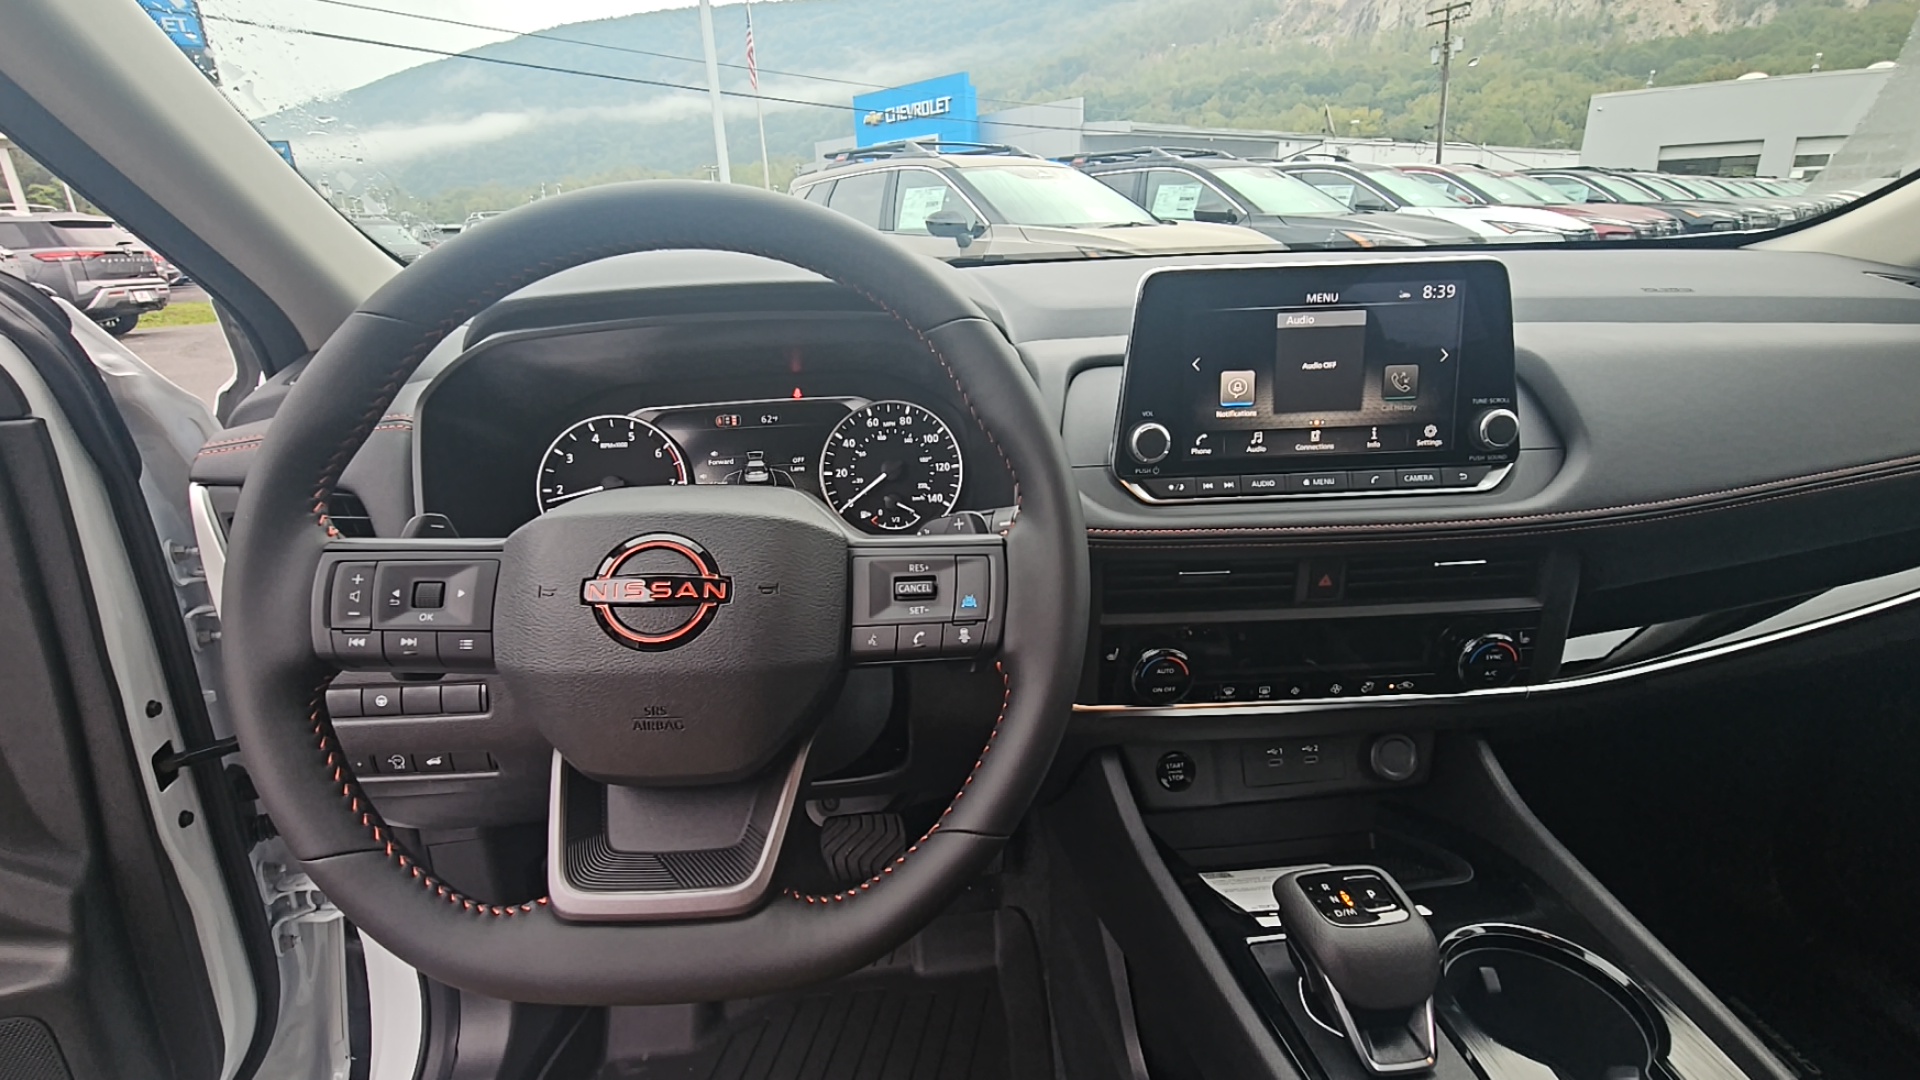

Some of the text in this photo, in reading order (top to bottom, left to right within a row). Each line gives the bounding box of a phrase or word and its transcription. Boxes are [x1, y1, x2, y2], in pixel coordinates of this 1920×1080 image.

[885, 96, 952, 123] CHEVROLET
[1422, 284, 1456, 299] 8:39
[1306, 293, 1339, 303] MENU
[1286, 315, 1315, 325] Audio
[1302, 361, 1337, 370] Audio OFF
[1381, 404, 1417, 412] Call History
[1216, 410, 1257, 418] Notifications
[866, 417, 879, 428] 60
[899, 416, 912, 425] 80
[591, 433, 600, 443] 4
[628, 431, 635, 441] 5
[923, 434, 939, 443] 100
[842, 439, 856, 448] 40
[1295, 442, 1335, 451] Connections
[1366, 440, 1381, 448] Info
[1416, 439, 1443, 448] Settings
[655, 449, 662, 458] 6
[1190, 447, 1212, 455] Phone
[1246, 445, 1267, 453] Audio
[566, 453, 574, 464] 3
[707, 458, 734, 466] Forward
[792, 456, 805, 464] OFF
[935, 462, 950, 471] 120
[835, 468, 848, 478] 20
[1312, 477, 1335, 486] MENU
[1404, 474, 1434, 483] CAMERA
[1251, 480, 1276, 488] AUDIO
[555, 484, 564, 495] 2
[927, 493, 943, 503] 140
[908, 563, 930, 572] RES+
[586, 580, 727, 599] NISSAN
[898, 584, 932, 593] CANCEL
[418, 613, 434, 622] OK
[643, 705, 668, 716] SRS
[632, 720, 685, 731] AIRBAG
[1166, 762, 1184, 770] START
[1168, 774, 1185, 782] STOP
[1321, 883, 1331, 891] R
[1366, 889, 1376, 899] P
[1328, 895, 1340, 904] N
[1334, 907, 1358, 918] D/M
